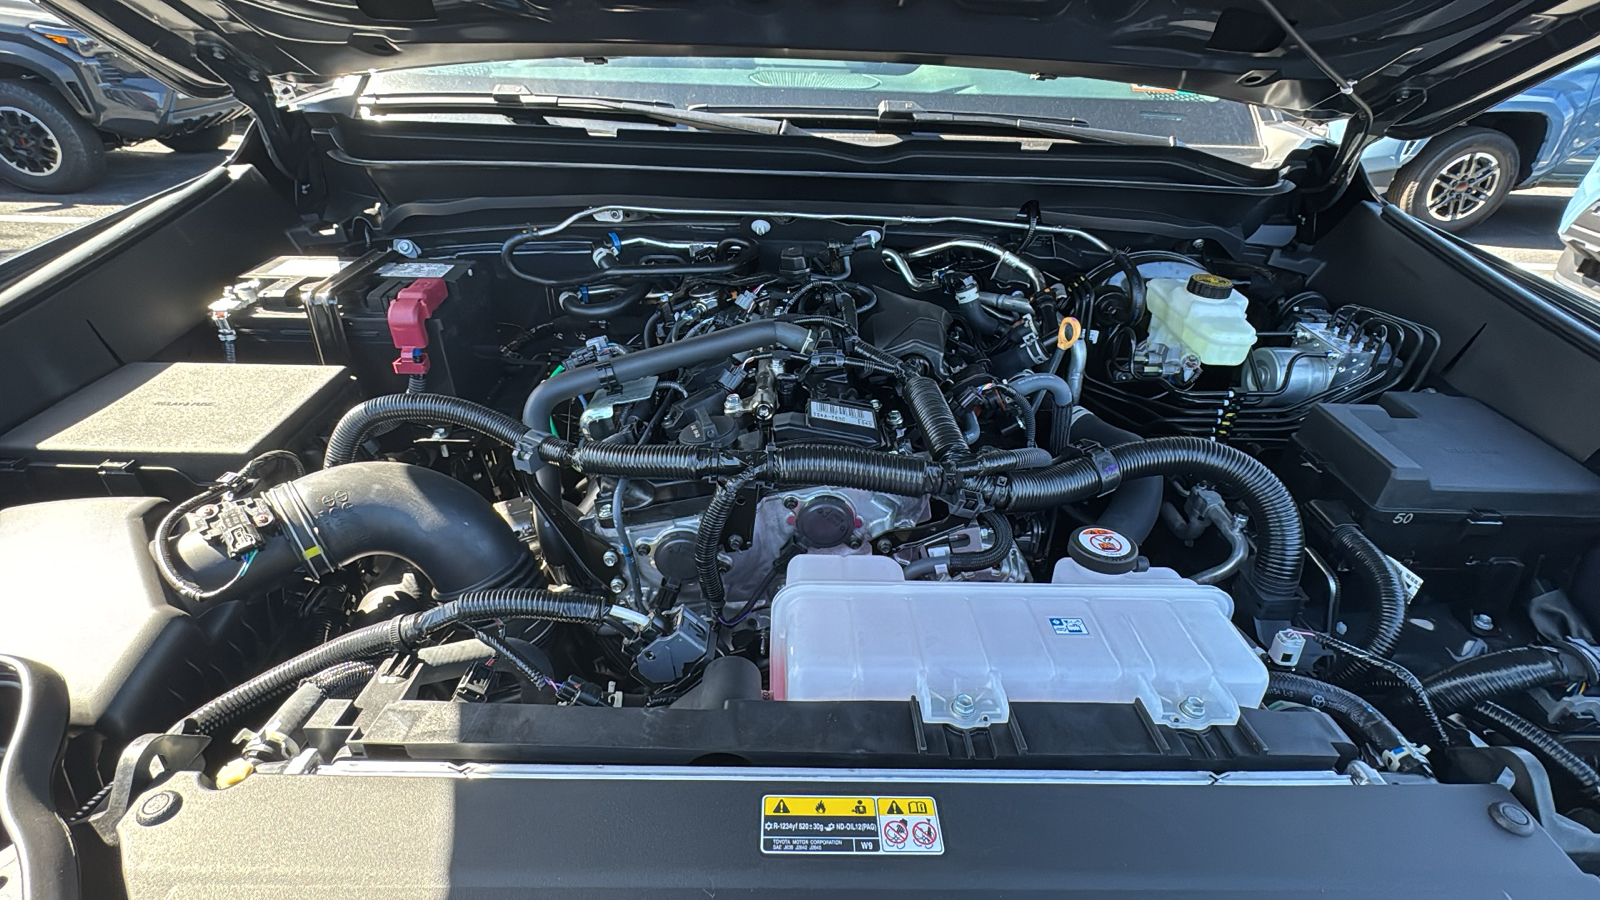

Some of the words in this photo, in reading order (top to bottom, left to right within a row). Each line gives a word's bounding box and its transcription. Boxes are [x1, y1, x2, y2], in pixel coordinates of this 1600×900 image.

[1392, 512, 1414, 524] 50
[773, 822, 798, 832] R-1234yf
[836, 822, 877, 832] ND-OIL12(PAG)
[860, 841, 874, 850] W9
